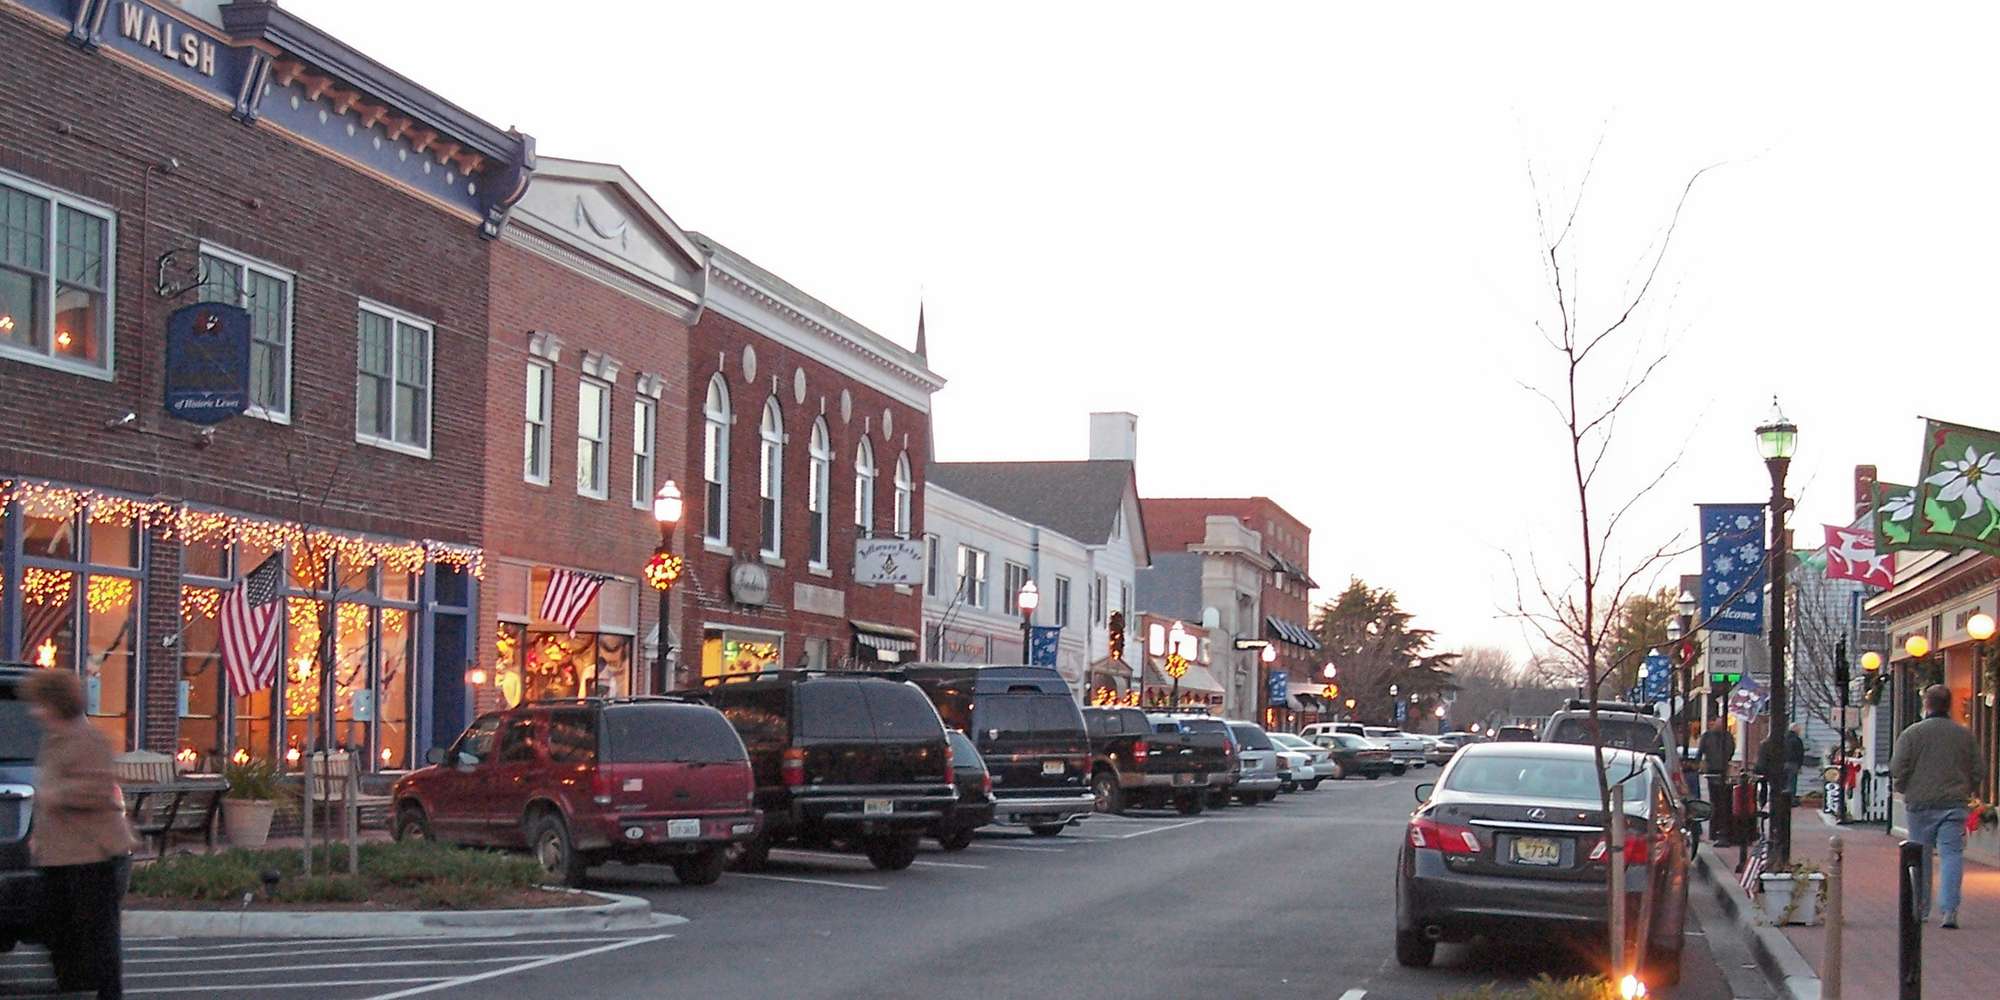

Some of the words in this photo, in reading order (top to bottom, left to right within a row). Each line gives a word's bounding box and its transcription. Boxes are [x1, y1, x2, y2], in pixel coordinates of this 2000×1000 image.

[121, 2, 216, 77] WALSH
[1710, 606, 1757, 620] Welcome
[1711, 646, 1743, 655] EMERGENCY
[1715, 660, 1737, 668] ROUTE
